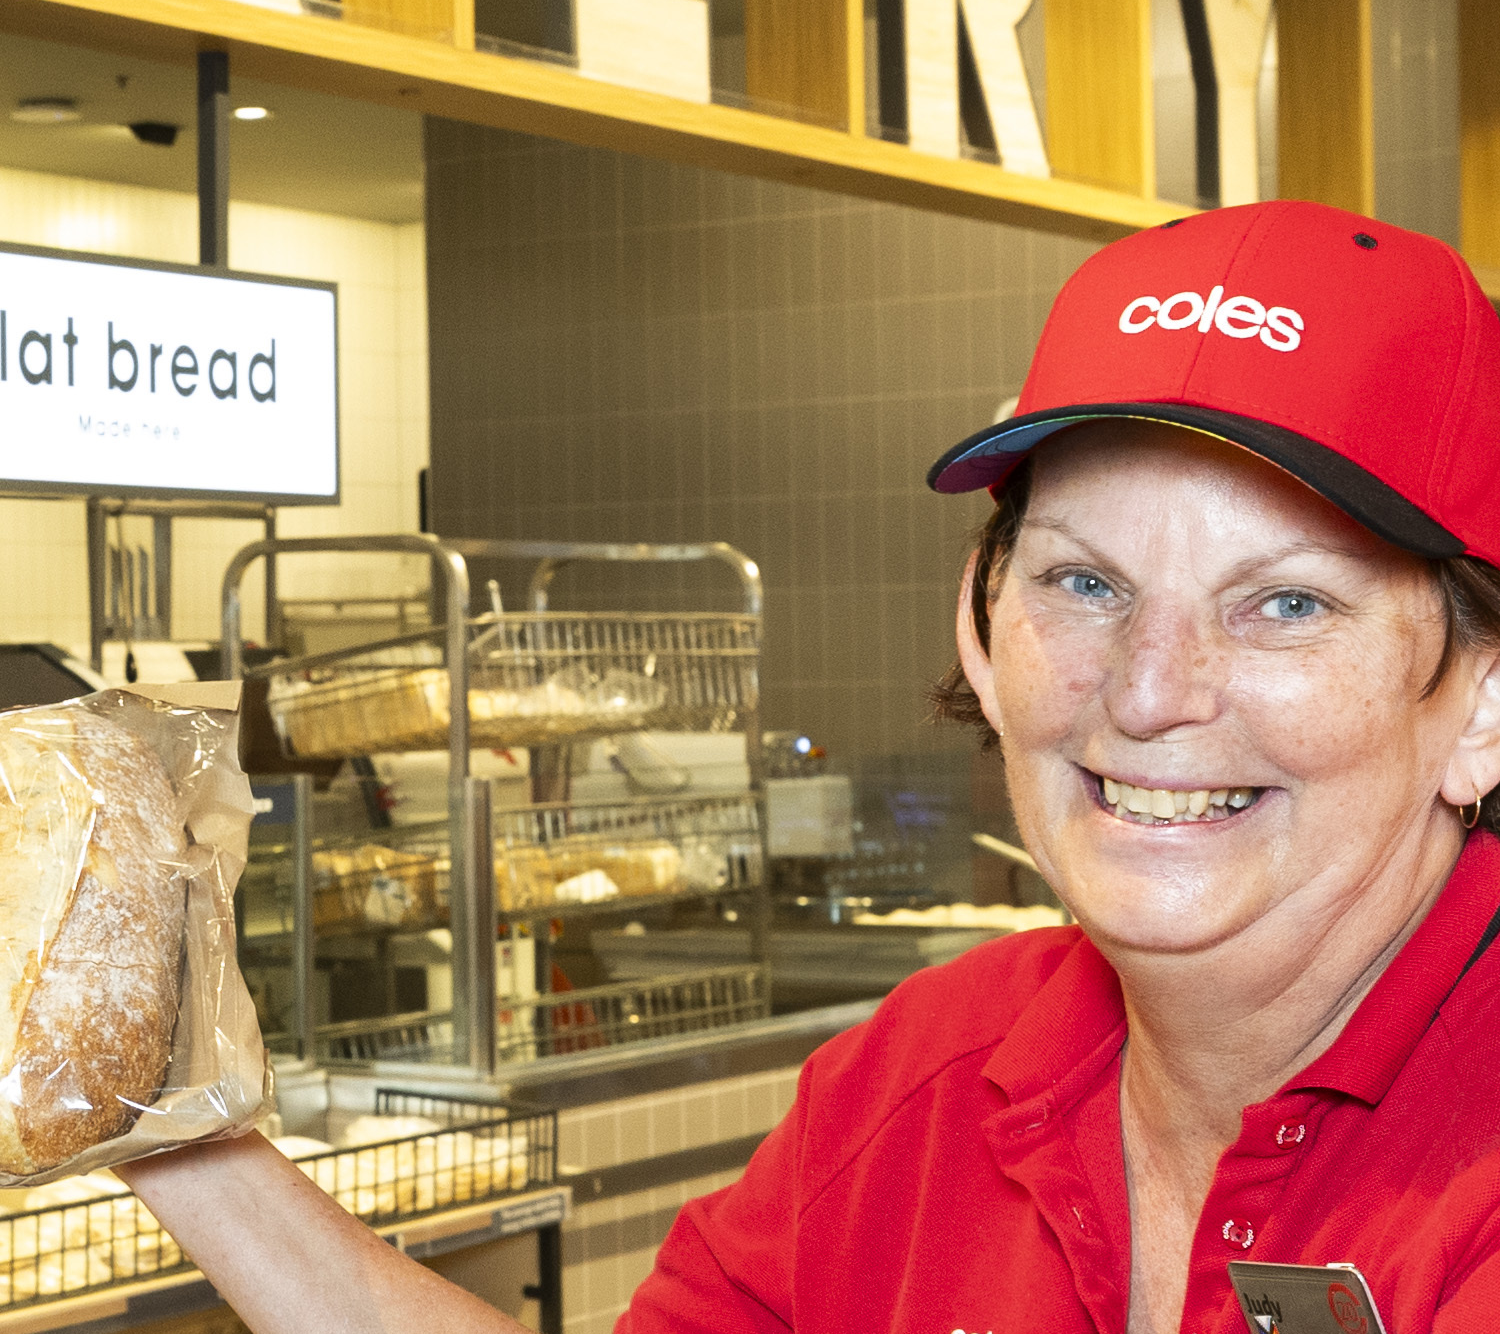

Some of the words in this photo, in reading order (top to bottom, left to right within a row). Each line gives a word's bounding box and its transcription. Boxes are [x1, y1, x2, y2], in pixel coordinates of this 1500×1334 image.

[1118, 284, 1305, 353] coles
[107, 320, 277, 403] bread
[1243, 1292, 1283, 1324] Judy
